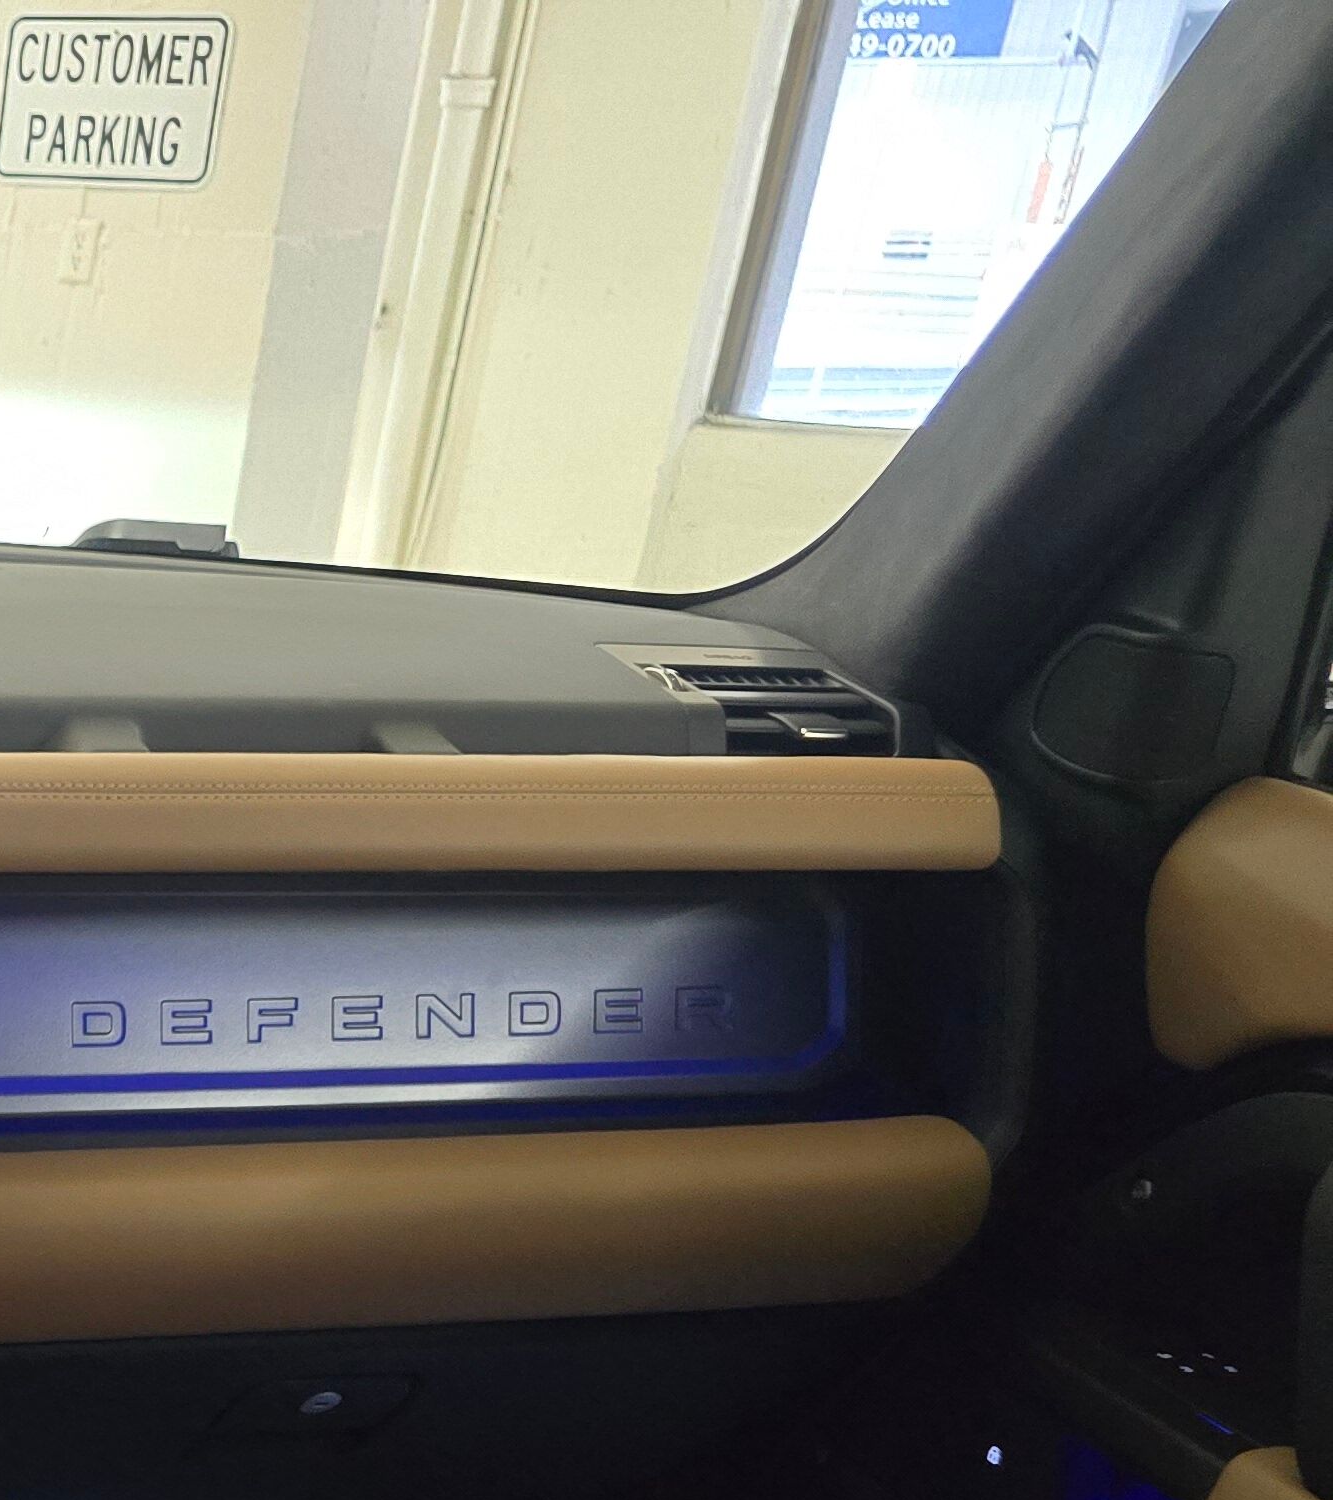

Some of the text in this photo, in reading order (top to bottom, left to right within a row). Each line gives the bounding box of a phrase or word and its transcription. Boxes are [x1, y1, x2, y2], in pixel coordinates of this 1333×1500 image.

[856, 11, 921, 29] Lease
[18, 33, 214, 85] CUSTOMER
[25, 114, 182, 165] PARKING
[70, 985, 733, 1048] DEFENDER
